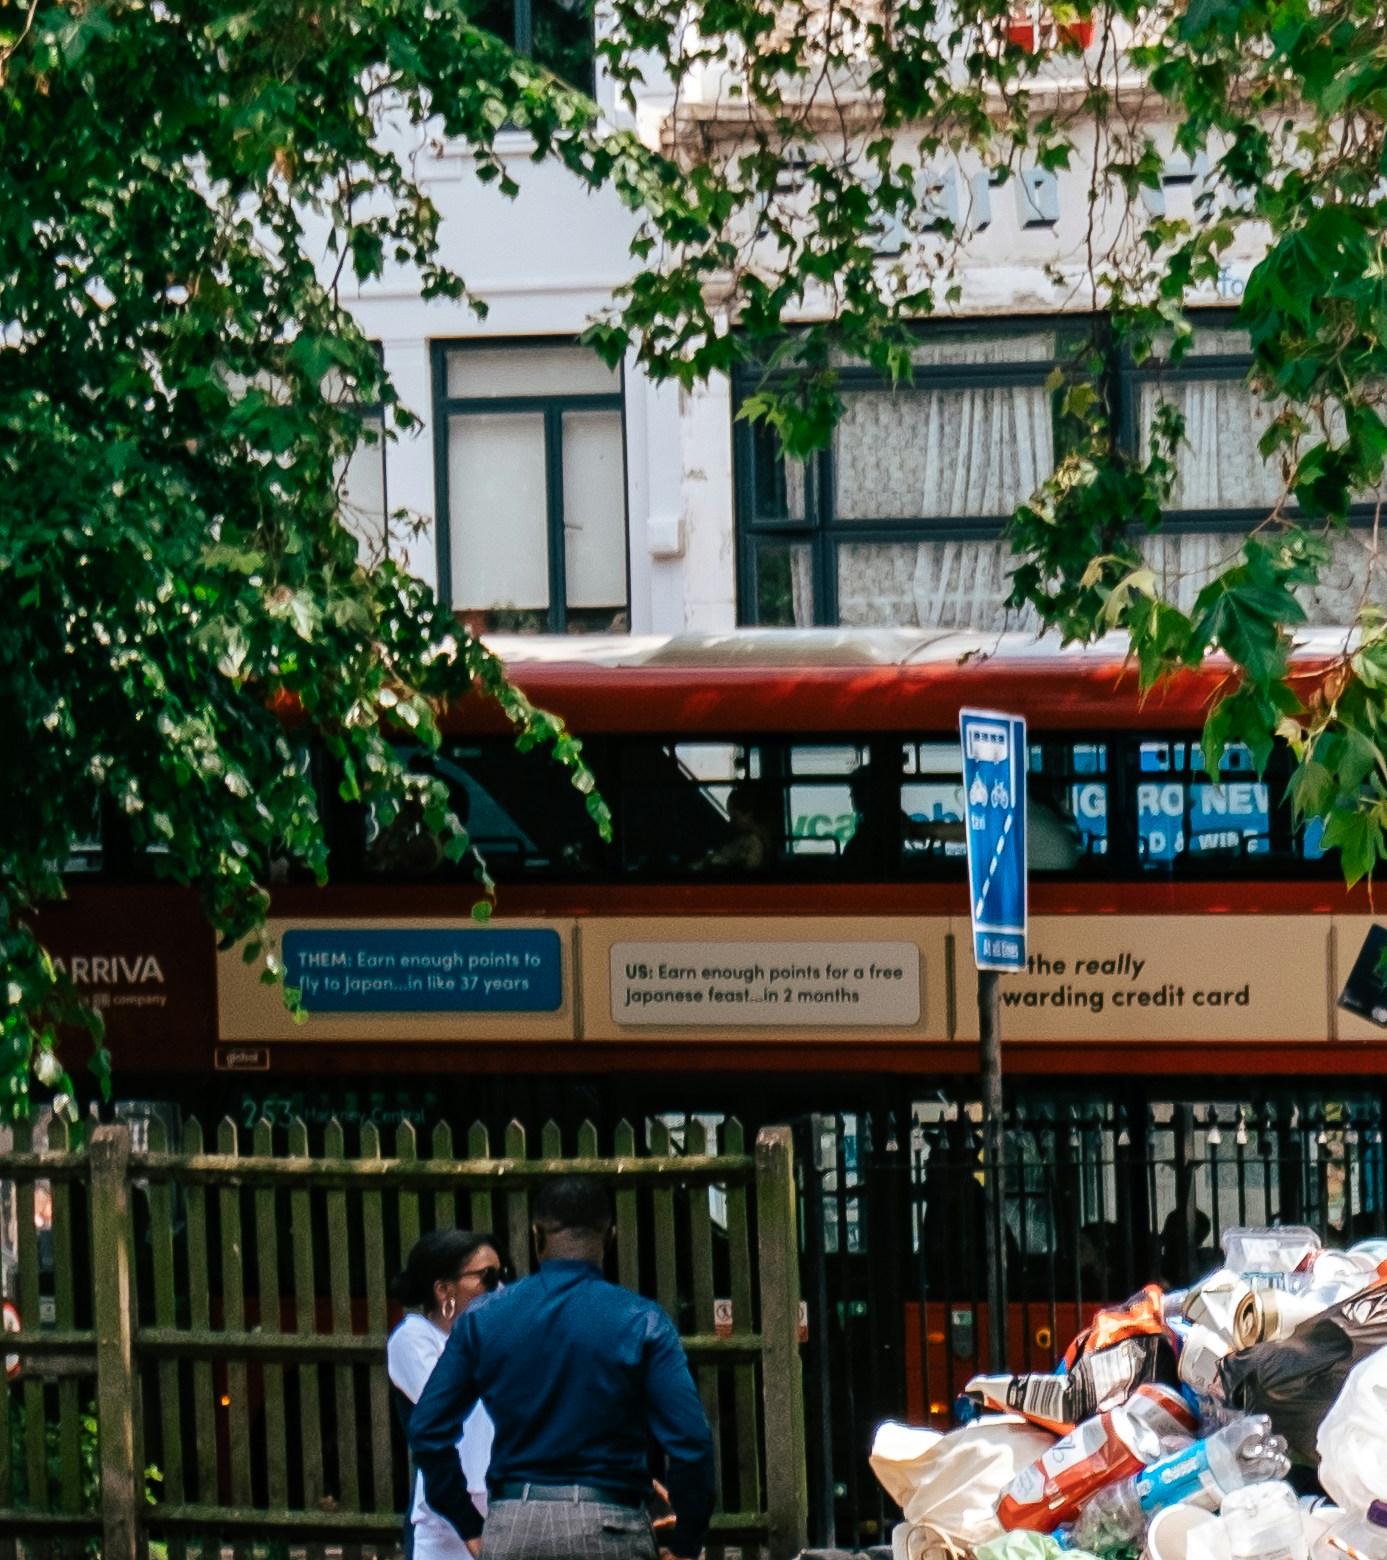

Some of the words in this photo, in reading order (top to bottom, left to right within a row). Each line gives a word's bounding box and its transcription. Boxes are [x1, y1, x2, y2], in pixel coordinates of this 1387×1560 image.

[299, 951, 352, 968] THEM:
[357, 951, 396, 968] Earn
[400, 950, 464, 970] enough
[468, 950, 521, 970] points
[525, 951, 542, 968] to
[1026, 953, 1067, 976] the
[1074, 952, 1146, 980] really
[625, 963, 653, 980] US:
[658, 963, 697, 980] Earn
[701, 963, 765, 984] enough
[769, 963, 821, 983] points
[825, 963, 849, 980] for
[853, 966, 865, 980] a
[869, 963, 904, 980] free
[299, 975, 320, 995] fly
[324, 976, 341, 990] to
[427, 975, 456, 990] like
[460, 976, 478, 990] 37
[484, 977, 530, 996] years
[624, 987, 704, 1007] Japanese
[783, 988, 793, 1003] 2
[797, 987, 860, 1003] months
[1000, 984, 1105, 1013] warding
[1111, 984, 1186, 1008] credit
[1192, 984, 1250, 1007] card
[242, 1096, 294, 1129] 253
[305, 1106, 367, 1127] Hackney
[371, 1106, 427, 1125] Central
